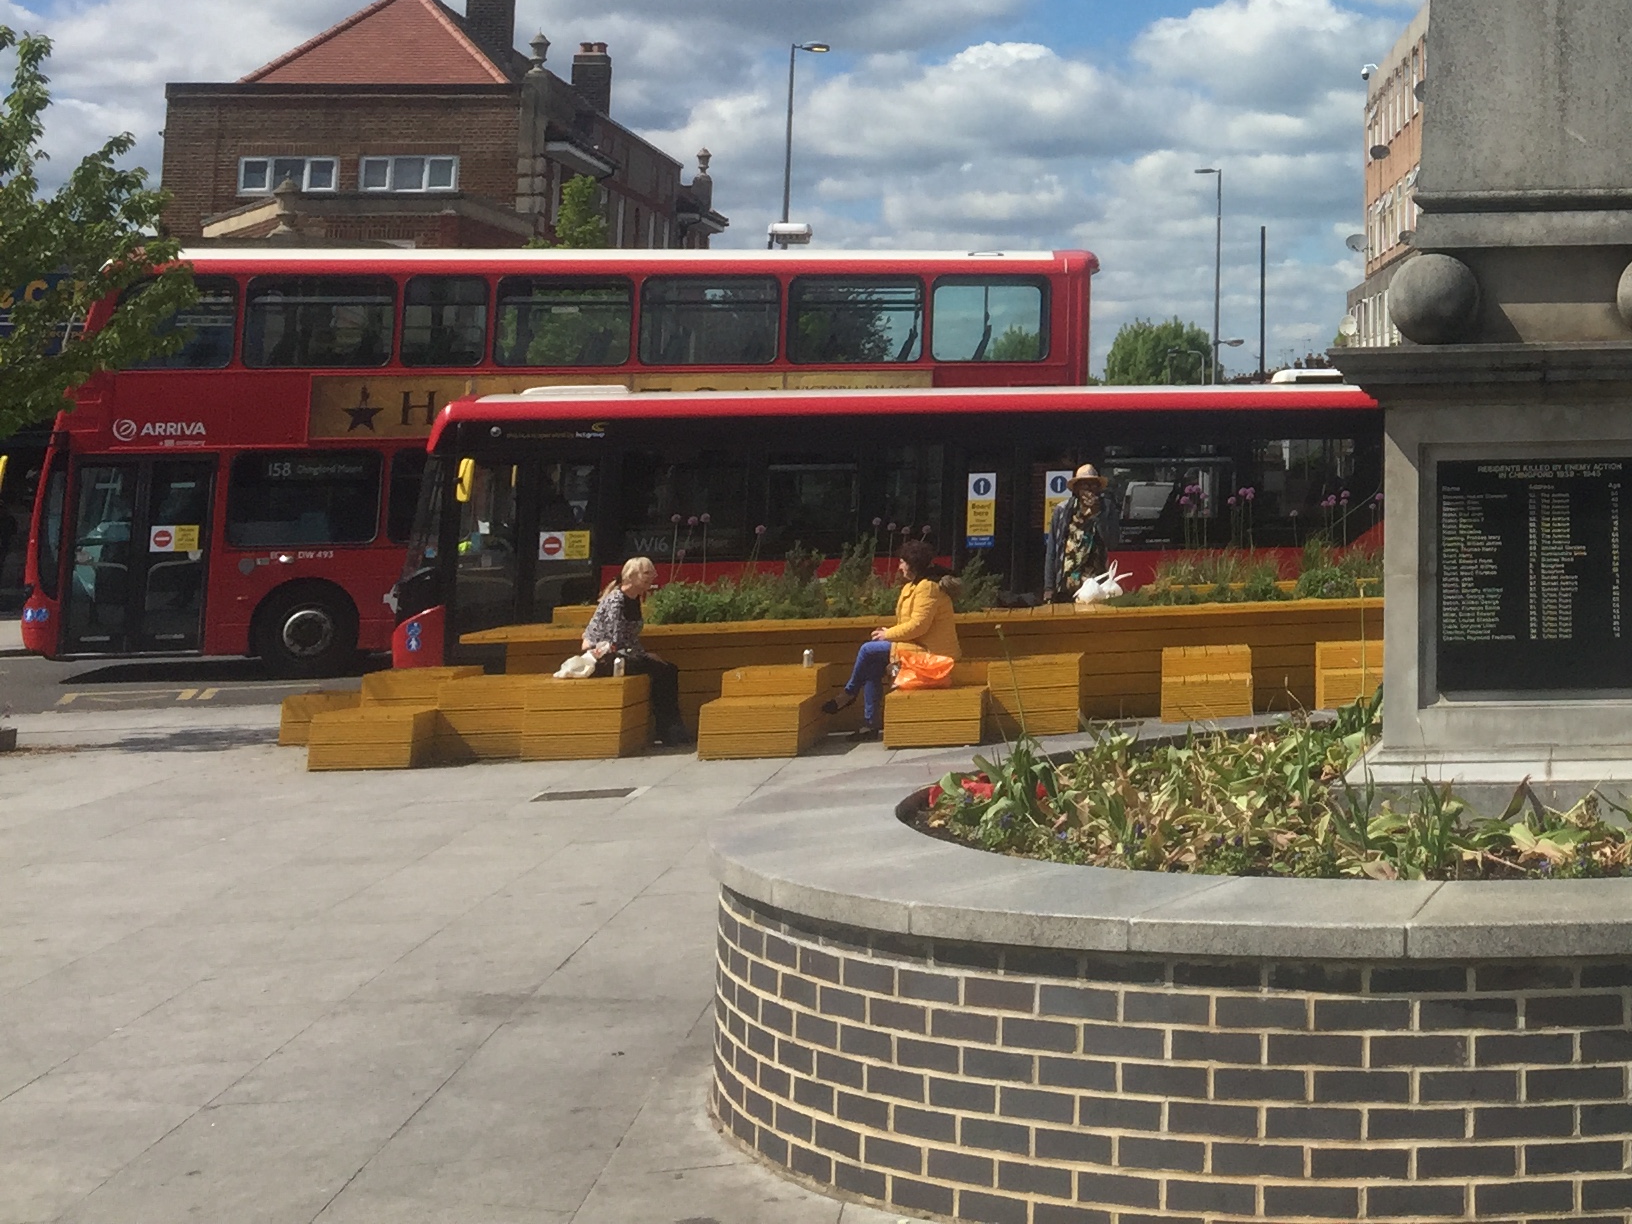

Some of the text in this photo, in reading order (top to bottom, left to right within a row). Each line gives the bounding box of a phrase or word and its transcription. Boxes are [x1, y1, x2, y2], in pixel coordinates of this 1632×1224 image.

[140, 422, 206, 436] ARRIVA
[268, 462, 292, 476] 158
[1478, 465, 1520, 473] RESIDENTS
[1592, 462, 1623, 470] ACTION
[634, 536, 669, 552] W16
[316, 550, 334, 558] 493
